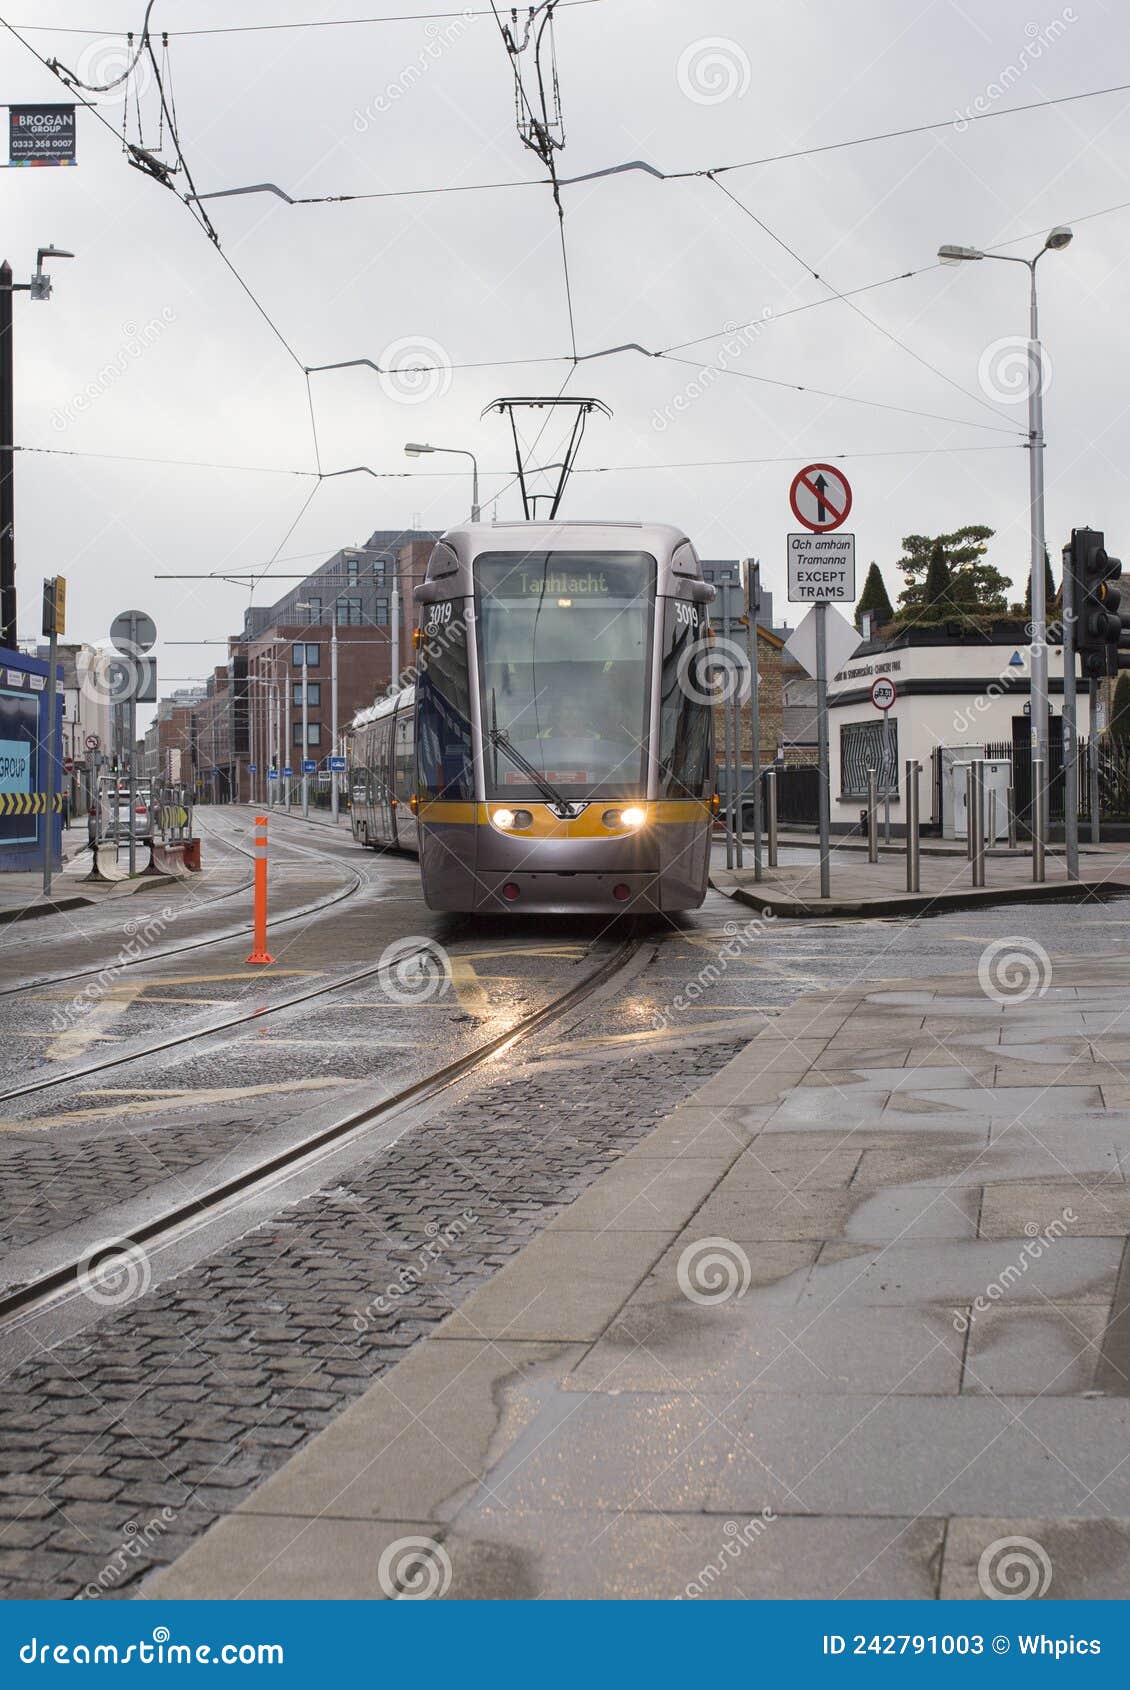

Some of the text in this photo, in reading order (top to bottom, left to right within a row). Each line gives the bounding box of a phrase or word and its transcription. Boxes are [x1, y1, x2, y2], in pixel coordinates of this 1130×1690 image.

[19, 115, 73, 126] BROGAN
[12, 140, 33, 148] 0333
[797, 554, 847, 565] Tramanna
[797, 571, 846, 582] EXCEPT
[799, 586, 845, 597] TRAMS
[430, 602, 452, 625] 3019
[674, 601, 699, 628] 3019
[0, 757, 25, 778] GROUP
